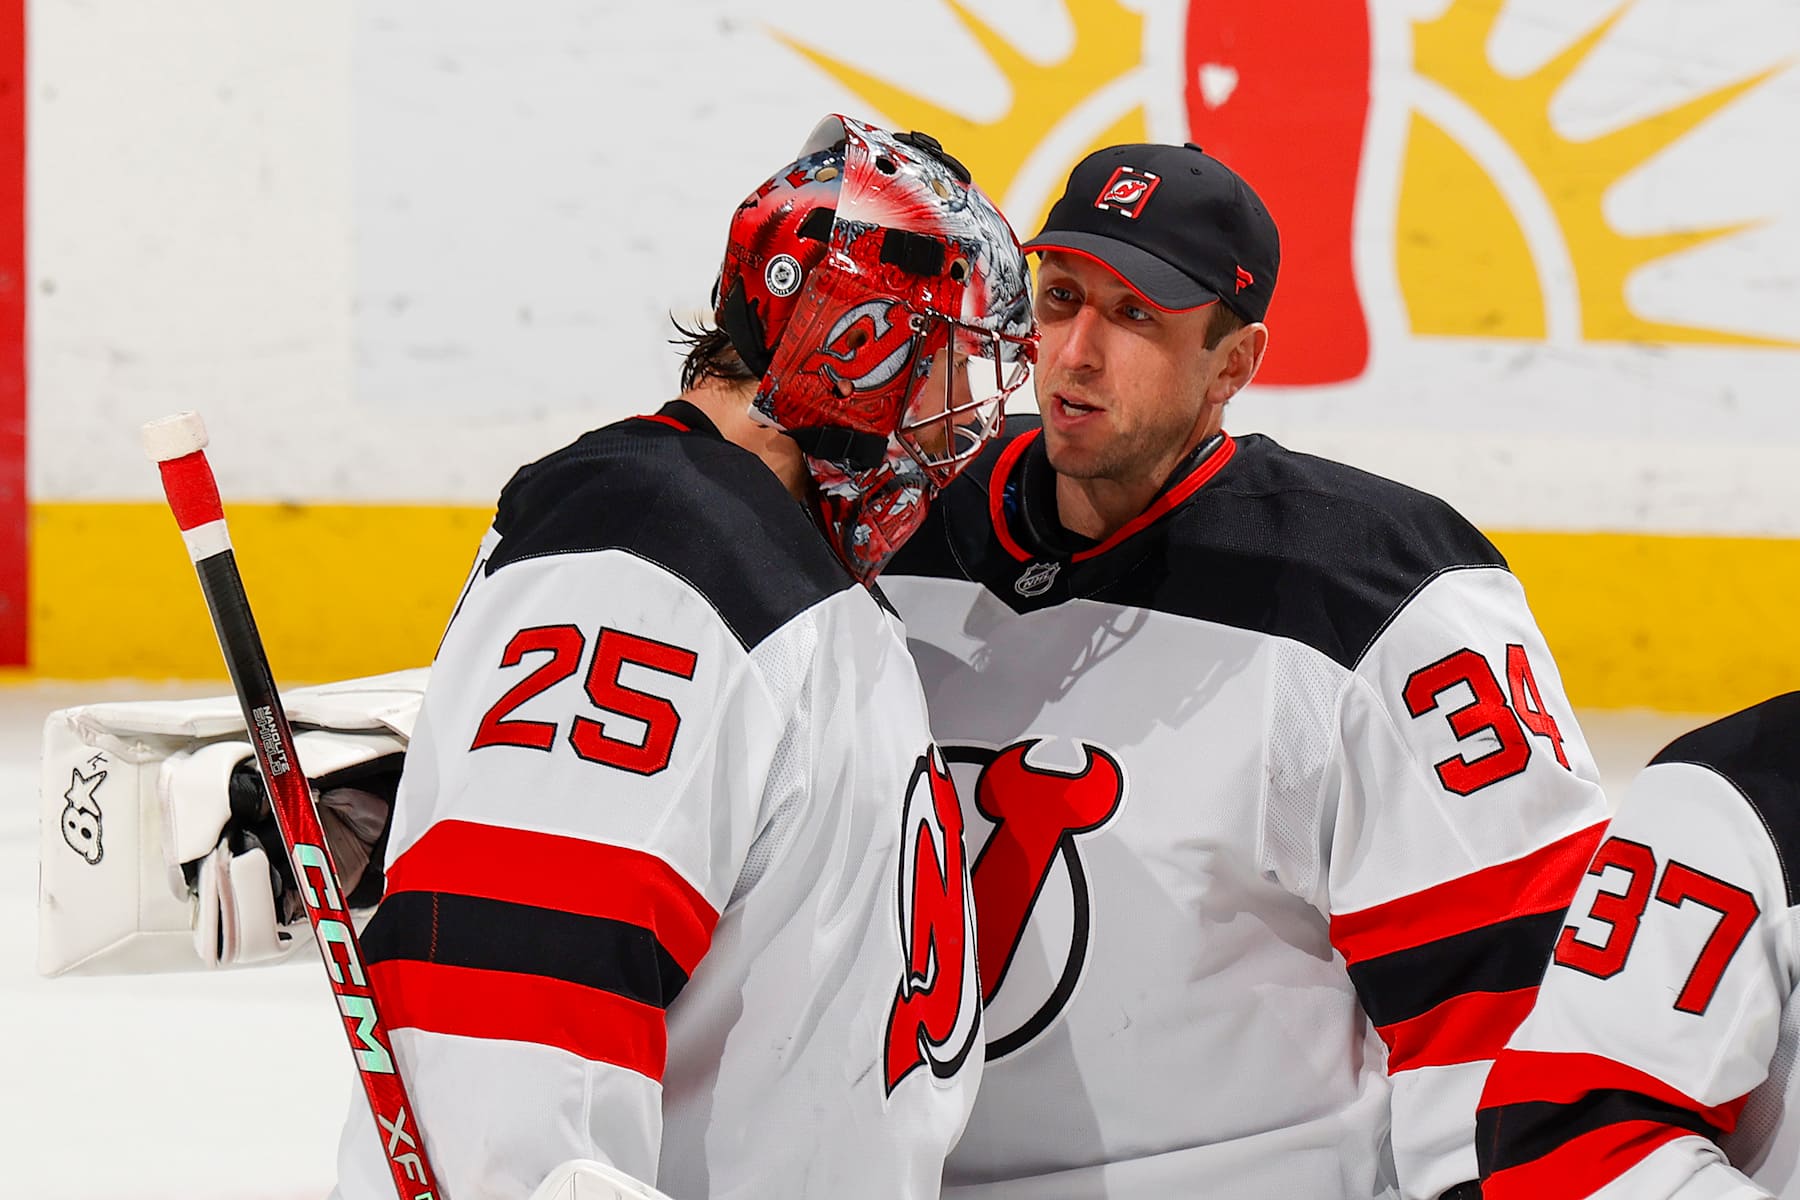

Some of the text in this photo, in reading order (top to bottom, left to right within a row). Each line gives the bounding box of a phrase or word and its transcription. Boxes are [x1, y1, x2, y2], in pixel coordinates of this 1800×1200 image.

[252, 706, 283, 777] SHIELD
[263, 705, 290, 773] NANOLITE
[469, 624, 698, 776] 25
[1402, 644, 1572, 797] 34
[291, 843, 397, 1075] CCM
[1553, 836, 1761, 1017] 37
